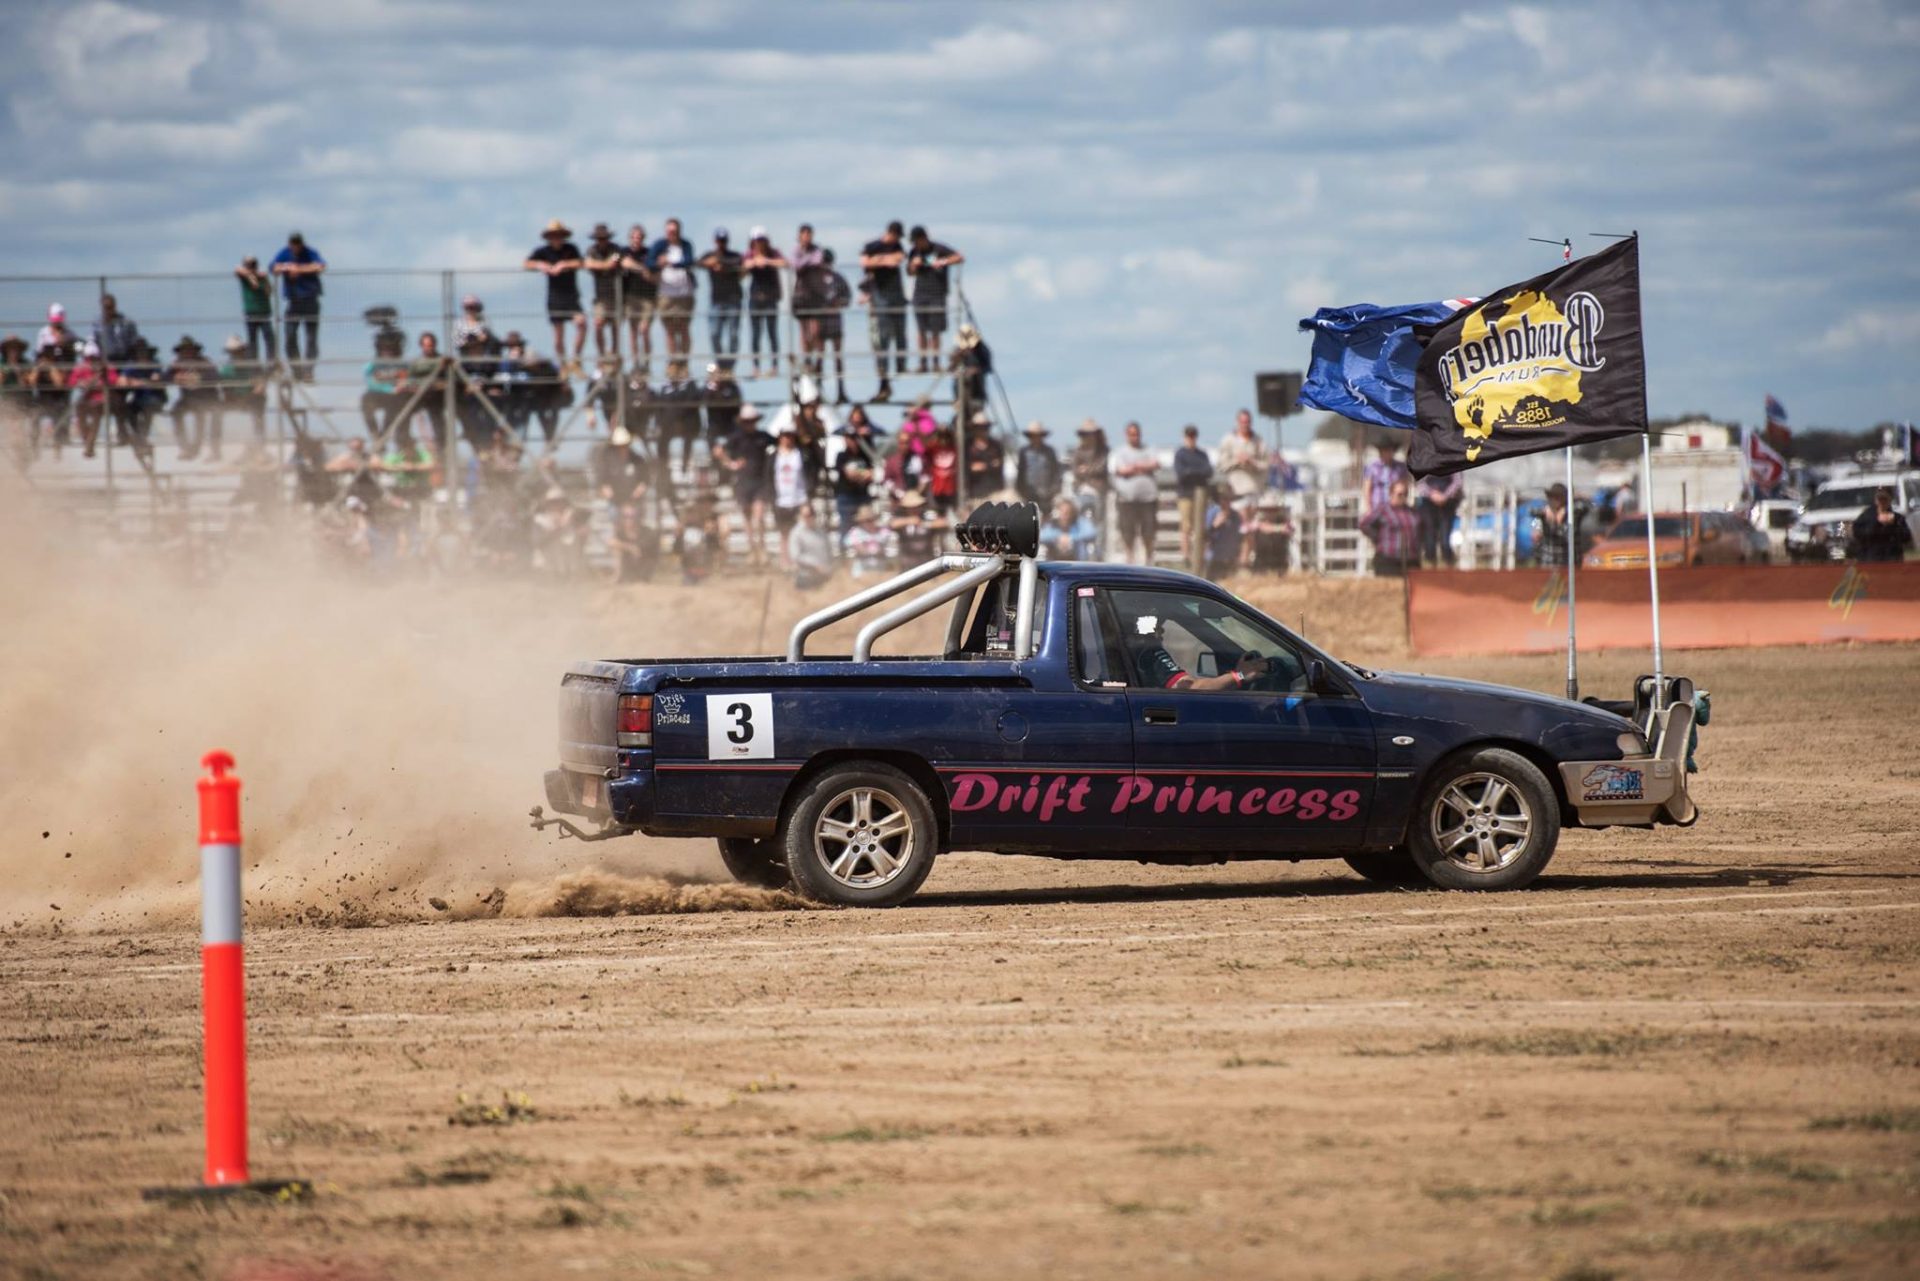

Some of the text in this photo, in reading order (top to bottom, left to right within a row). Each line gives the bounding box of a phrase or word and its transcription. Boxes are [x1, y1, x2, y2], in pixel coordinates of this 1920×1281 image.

[657, 693, 686, 704] Drift
[656, 713, 691, 725] Princess
[726, 702, 755, 744] 3
[948, 773, 1360, 821] Drift Princess
